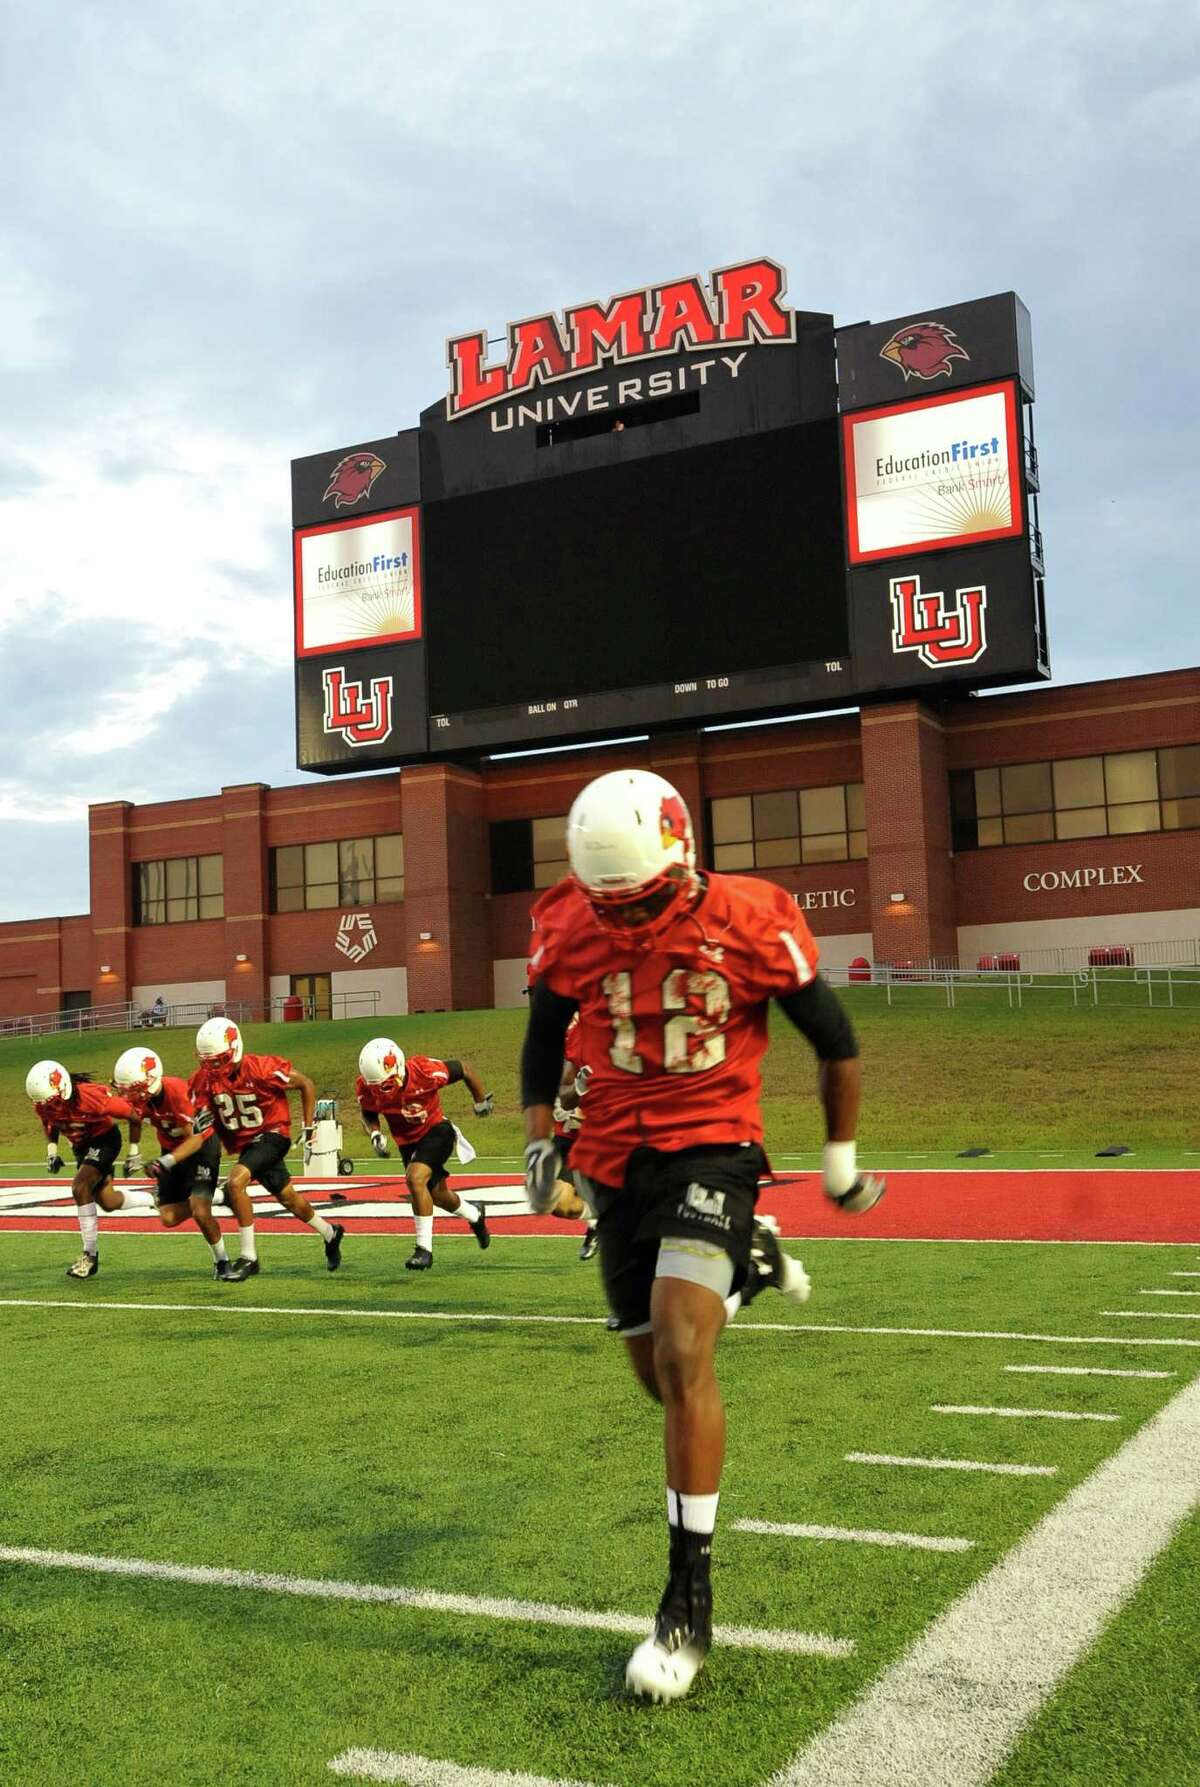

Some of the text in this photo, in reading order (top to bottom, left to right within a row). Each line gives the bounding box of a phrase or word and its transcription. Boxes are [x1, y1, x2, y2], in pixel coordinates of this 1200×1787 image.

[445, 256, 797, 421] LAMAR
[491, 352, 748, 433] UNIVERSITY
[876, 437, 999, 477] EducationFirst
[318, 552, 408, 583] EducationFirst
[890, 575, 987, 669] LU
[706, 677, 729, 689] TO GO
[825, 661, 842, 673] TOL
[563, 699, 578, 709] QTR
[674, 682, 697, 693] DOWN
[322, 666, 393, 747] LU
[436, 717, 451, 728] TOL
[528, 702, 557, 715] BALL ON
[792, 864, 1145, 910] LETIC COMPLEX
[213, 1093, 264, 1131] 25
